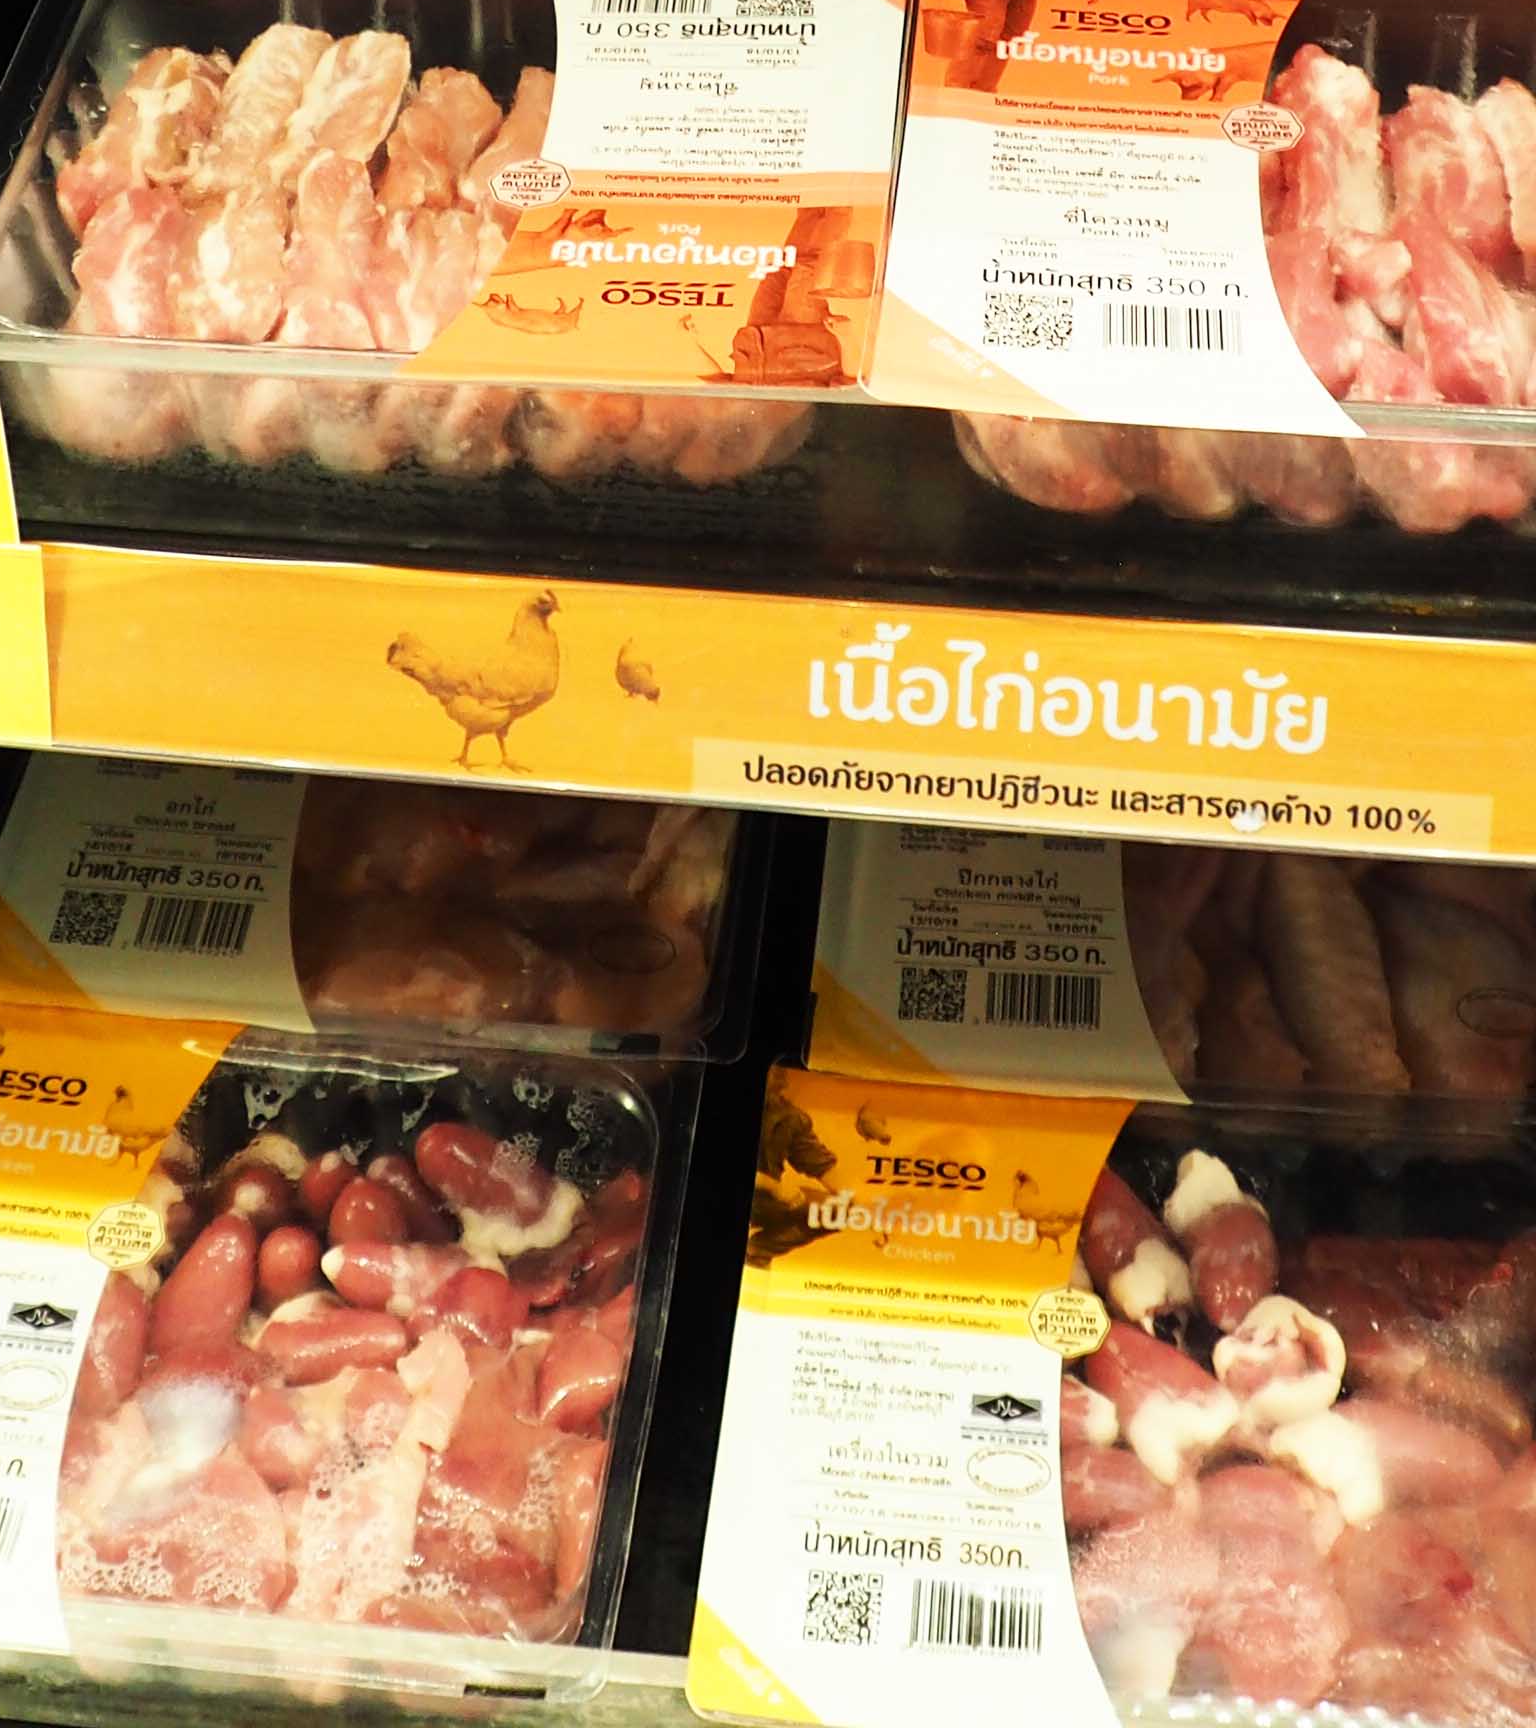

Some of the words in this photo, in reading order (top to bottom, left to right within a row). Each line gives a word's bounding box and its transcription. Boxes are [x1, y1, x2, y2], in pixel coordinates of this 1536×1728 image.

[617, 22, 670, 38] 350
[681, 17, 817, 45] น้ำหนักสุทธิ
[1051, 9, 1171, 29] TESCO
[996, 32, 1227, 75] เนื้อหมูอนามัย
[657, 222, 701, 235] Pork
[550, 240, 797, 282] เนื้อหมูอนามัย
[982, 259, 1133, 296] น้ำหนักสุทธิ
[1147, 276, 1206, 297] 350
[601, 288, 736, 307] TESCO
[808, 626, 1329, 755] เนื้อไก่อนามัย
[742, 757, 1098, 810] ปลอดภัยจากยาปฏิชีวนะ
[1347, 805, 1436, 836] 100%
[66, 854, 182, 892] น้ำหนักสุทธิ
[186, 869, 239, 890] 350
[1047, 892, 1081, 908] wing
[896, 927, 1016, 966] น้ำหนักสุทธิ
[1024, 943, 1078, 963] 350
[866, 1156, 986, 1183] TESCO
[808, 1188, 1038, 1245] เนื้อไก่อนามัย
[883, 1243, 956, 1263] Chicken
[803, 1519, 943, 1571] น้ำหนักสุทธิ
[960, 1541, 1030, 1570] 350ก.
